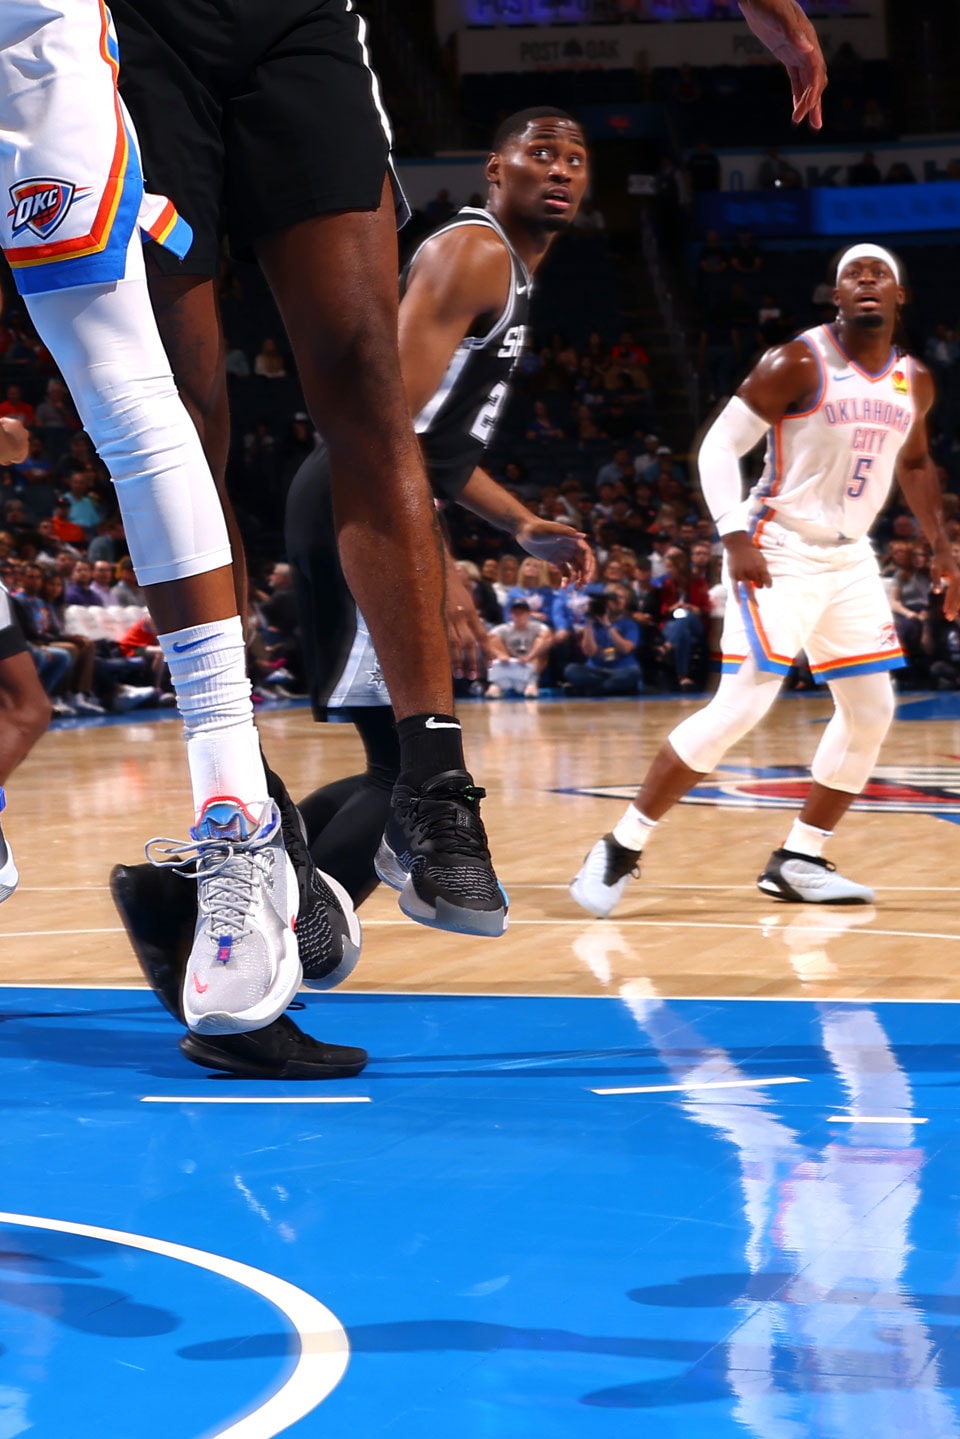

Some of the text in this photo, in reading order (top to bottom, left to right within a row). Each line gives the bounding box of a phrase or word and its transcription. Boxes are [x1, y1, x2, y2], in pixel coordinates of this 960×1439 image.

[519, 41, 560, 61] POST
[12, 188, 59, 231] OKC
[822, 398, 913, 435] OKLAHOMA
[851, 427, 889, 455] CITY
[845, 455, 874, 500] 5
